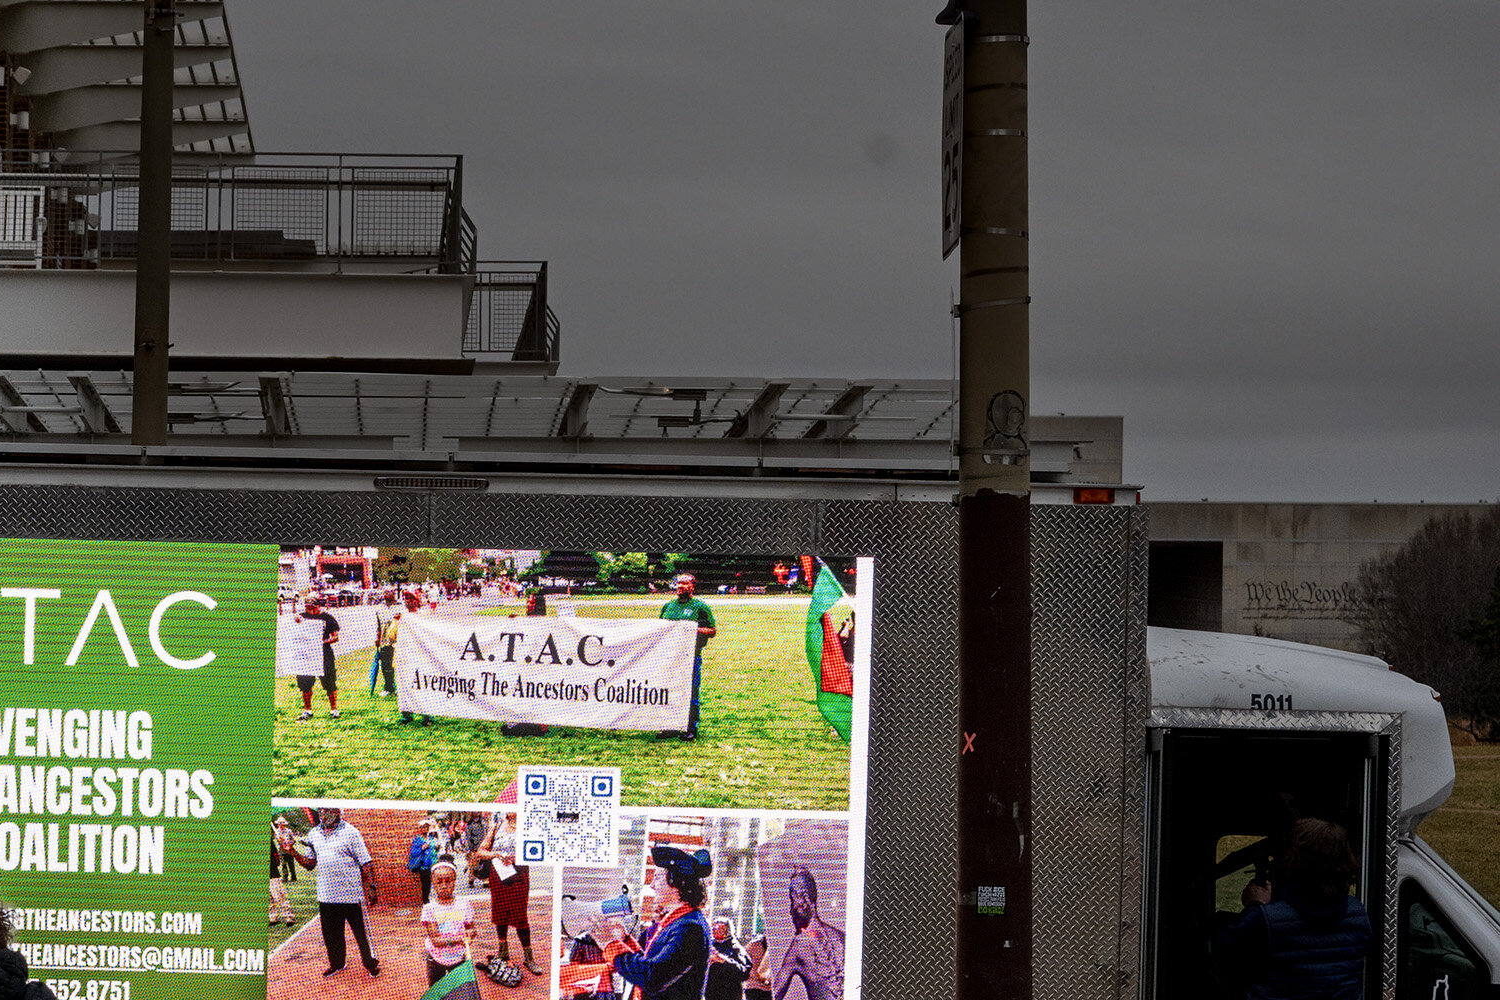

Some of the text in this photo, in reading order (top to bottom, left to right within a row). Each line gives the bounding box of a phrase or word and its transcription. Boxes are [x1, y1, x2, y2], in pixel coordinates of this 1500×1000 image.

[945, 92, 960, 137] LIMIT
[944, 141, 959, 232] 25
[1245, 581, 1272, 603] We
[1273, 580, 1299, 602] the
[460, 631, 616, 667] A.T.A.C.
[412, 668, 669, 705] Avenging The Ancestors Coalition
[1251, 693, 1292, 711] 5011
[4, 908, 202, 935] GTHEANCESTORS.COM
